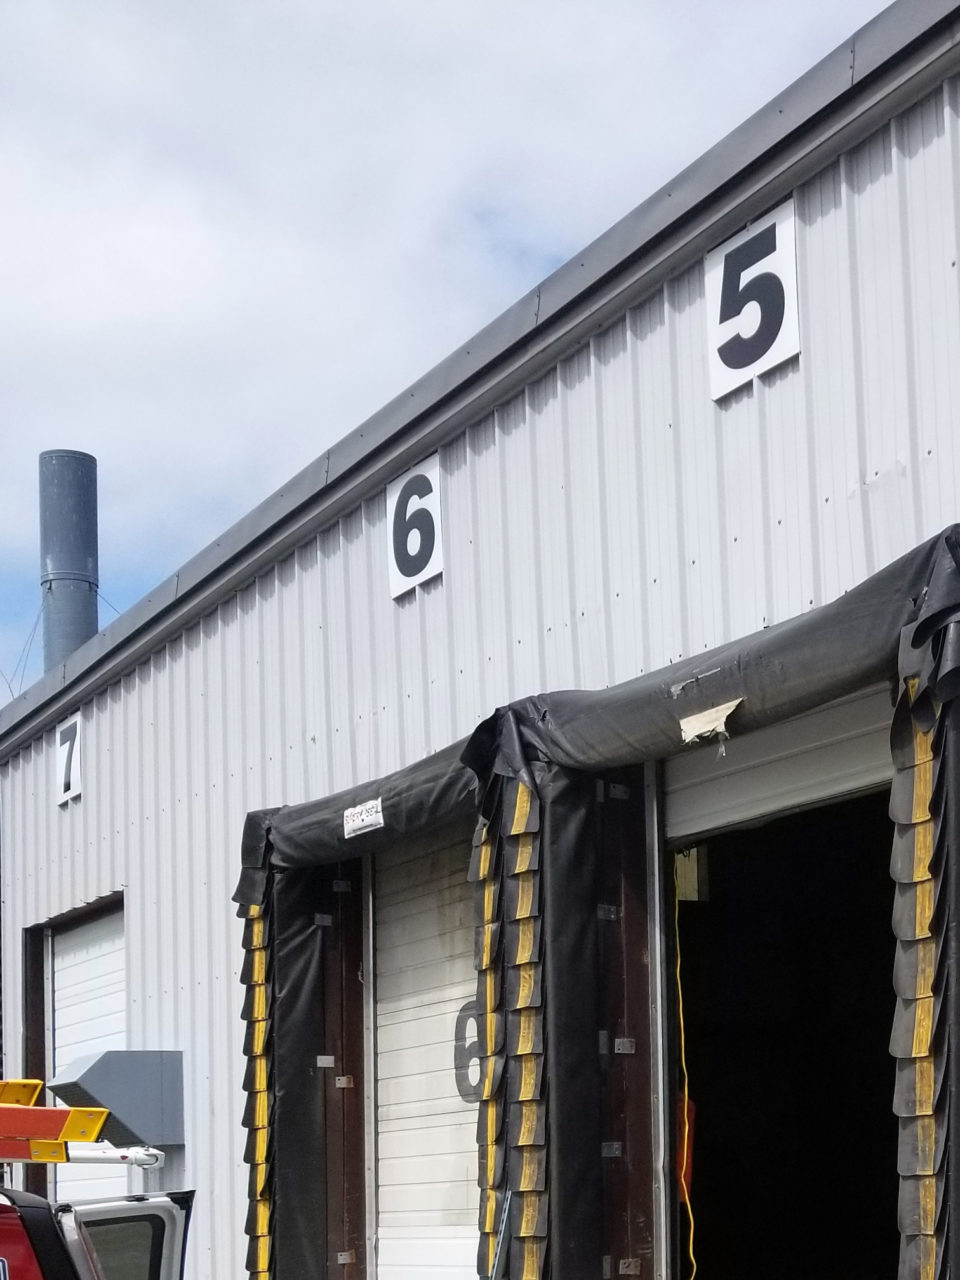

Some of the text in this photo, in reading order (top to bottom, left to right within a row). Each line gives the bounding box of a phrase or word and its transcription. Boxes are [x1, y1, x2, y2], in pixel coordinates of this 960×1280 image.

[717, 222, 785, 369] 5
[393, 474, 435, 577] 6
[60, 720, 77, 794] 7
[454, 1000, 480, 1104] 6
